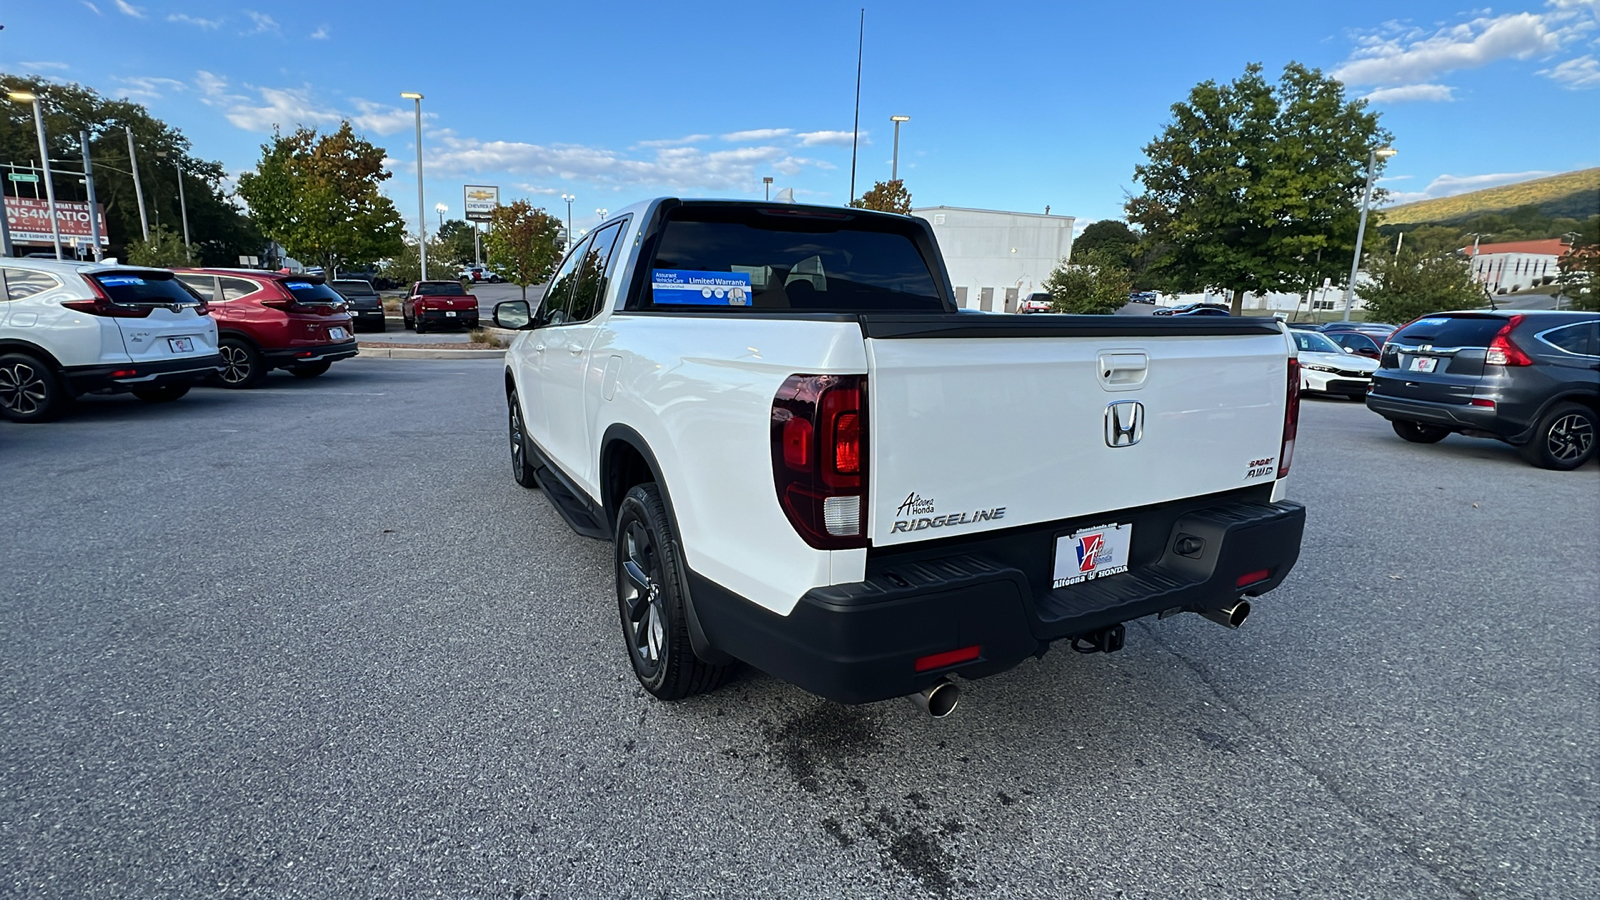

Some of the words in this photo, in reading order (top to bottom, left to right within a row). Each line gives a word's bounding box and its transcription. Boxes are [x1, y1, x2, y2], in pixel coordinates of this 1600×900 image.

[6, 206, 103, 223] NS4MATIO
[689, 277, 715, 285] Limited
[715, 278, 746, 286] Warranty
[1243, 466, 1274, 480] AWD
[912, 506, 935, 516] Honda
[890, 507, 1007, 534] RIDGELINE
[1053, 575, 1085, 589] Altoona
[1098, 565, 1128, 577] HONDA
